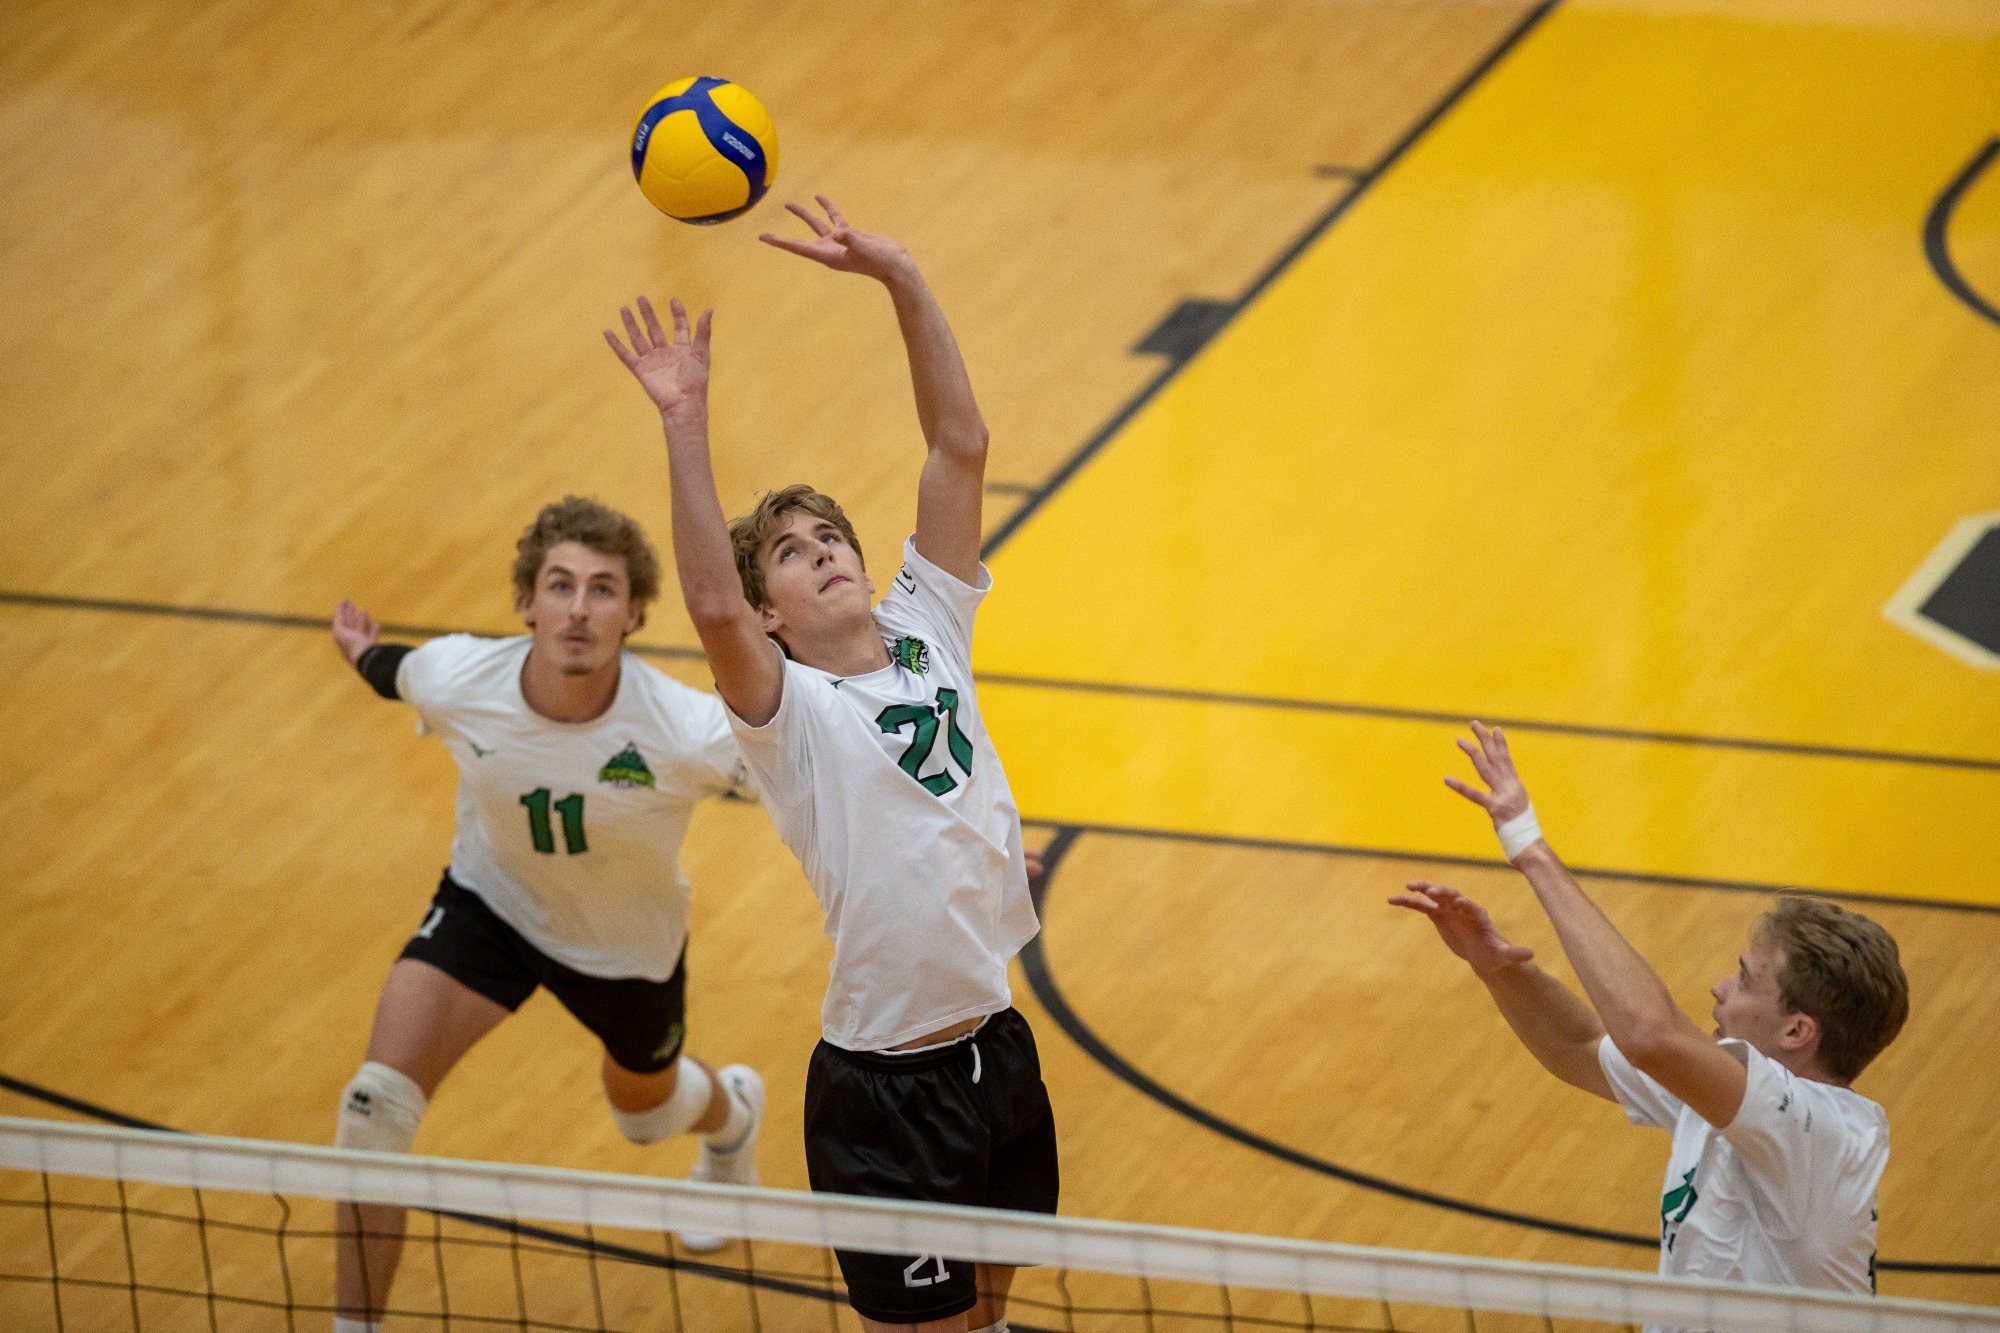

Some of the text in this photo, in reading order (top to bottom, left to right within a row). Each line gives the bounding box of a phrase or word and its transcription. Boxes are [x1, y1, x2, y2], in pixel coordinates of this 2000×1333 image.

[874, 686, 974, 798] 21
[519, 787, 588, 855] 11
[903, 1251, 951, 1288] 21
